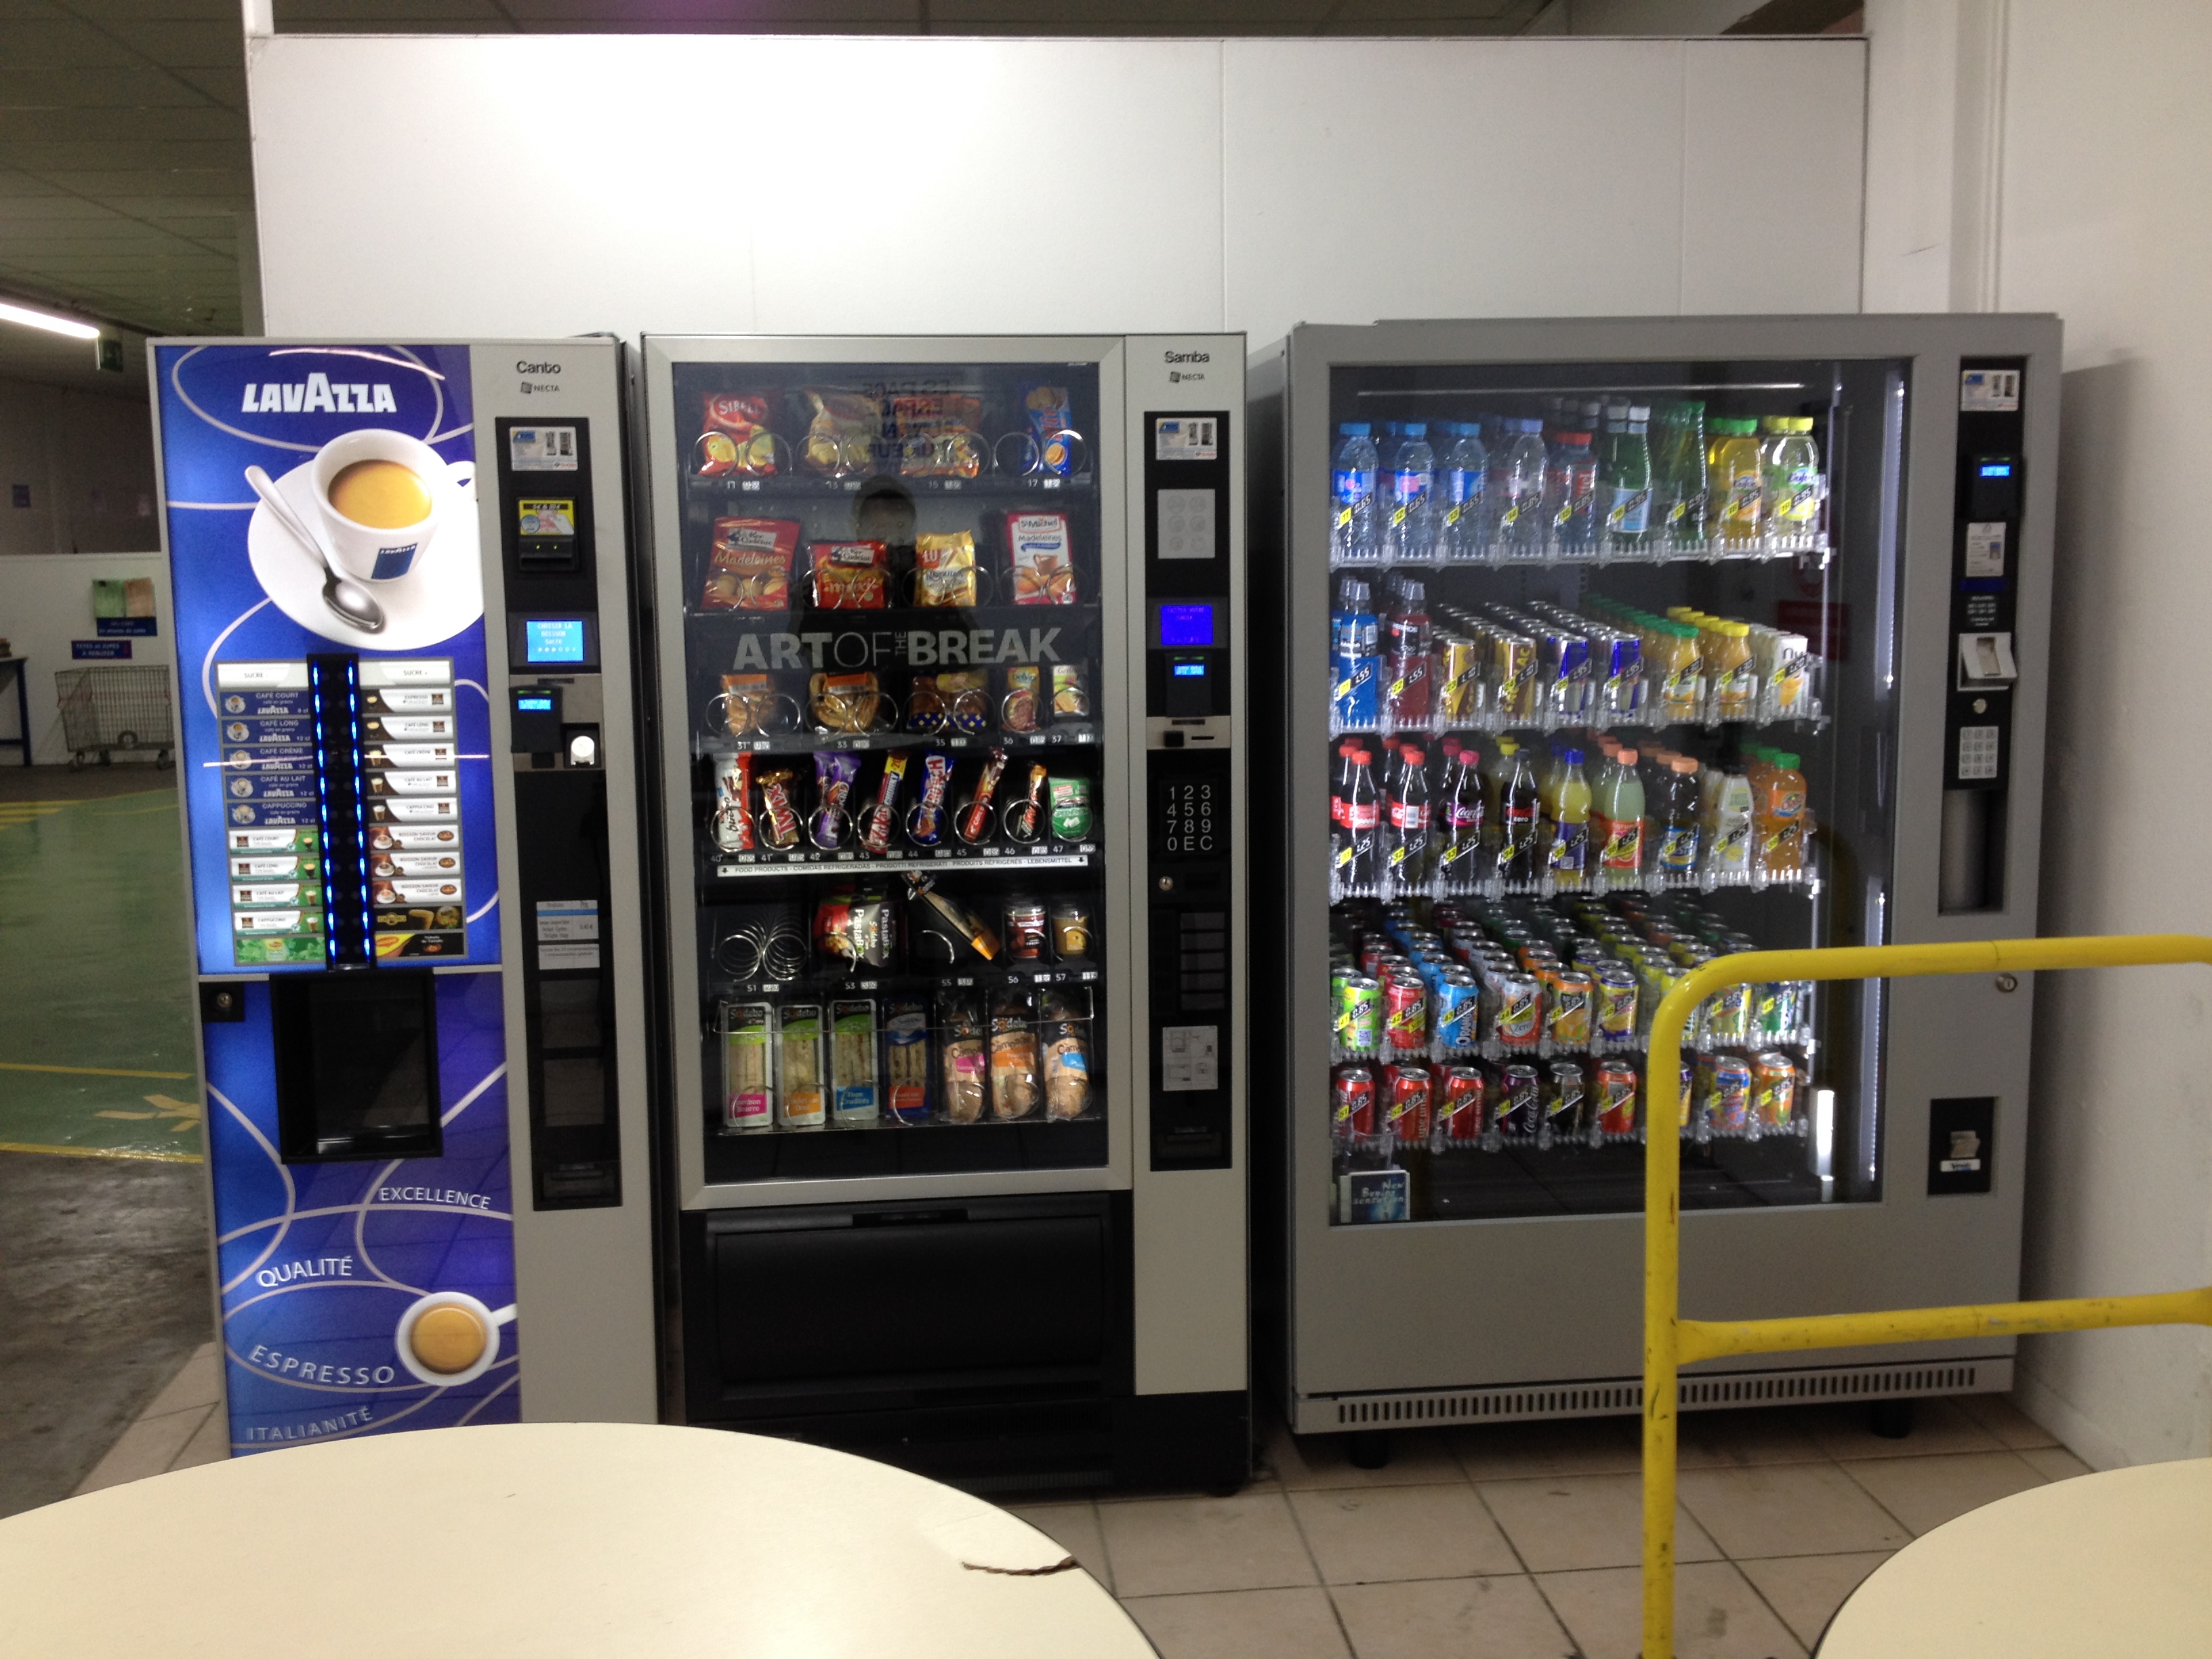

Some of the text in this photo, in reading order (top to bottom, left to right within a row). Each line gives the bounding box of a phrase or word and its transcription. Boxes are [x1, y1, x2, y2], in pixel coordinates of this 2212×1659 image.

[1164, 350, 1210, 364] Samba
[516, 361, 561, 374] Canto
[241, 372, 397, 413] LAVAZZA
[534, 384, 560, 392] NECTA
[1019, 534, 1062, 542] Madeleines
[714, 551, 786, 566] Madeleines
[733, 632, 833, 670] ART
[834, 632, 891, 668] OF
[908, 628, 1062, 665] BREAK
[258, 705, 289, 714] LAVAZZA
[259, 733, 291, 743] LAVAZZA
[262, 761, 293, 771] LAVAZZA
[263, 788, 295, 798] LAVAZZA
[1169, 785, 1211, 800] 1 2 3
[262, 802, 307, 810] CAPPUCCINO
[766, 782, 796, 841] TWIX
[1167, 802, 1211, 817] 4 5 6
[264, 815, 295, 825] LAVAZZA
[1167, 819, 1212, 834] 7 8 9
[1167, 836, 1213, 851] 0 E C
[908, 850, 918, 858] 44
[824, 861, 870, 870] REFRIGERADAS
[953, 859, 983, 867] PRODUITS
[1027, 856, 1071, 865] LEBENSMITTEL
[1008, 976, 1019, 984] 56
[1056, 973, 1066, 981] 57
[379, 1187, 491, 1210] EXCELLENCE
[257, 1255, 353, 1288] QUALITÉ
[249, 1344, 395, 1385] ESPRESSO
[246, 1406, 373, 1441] ITALIANITÉ
